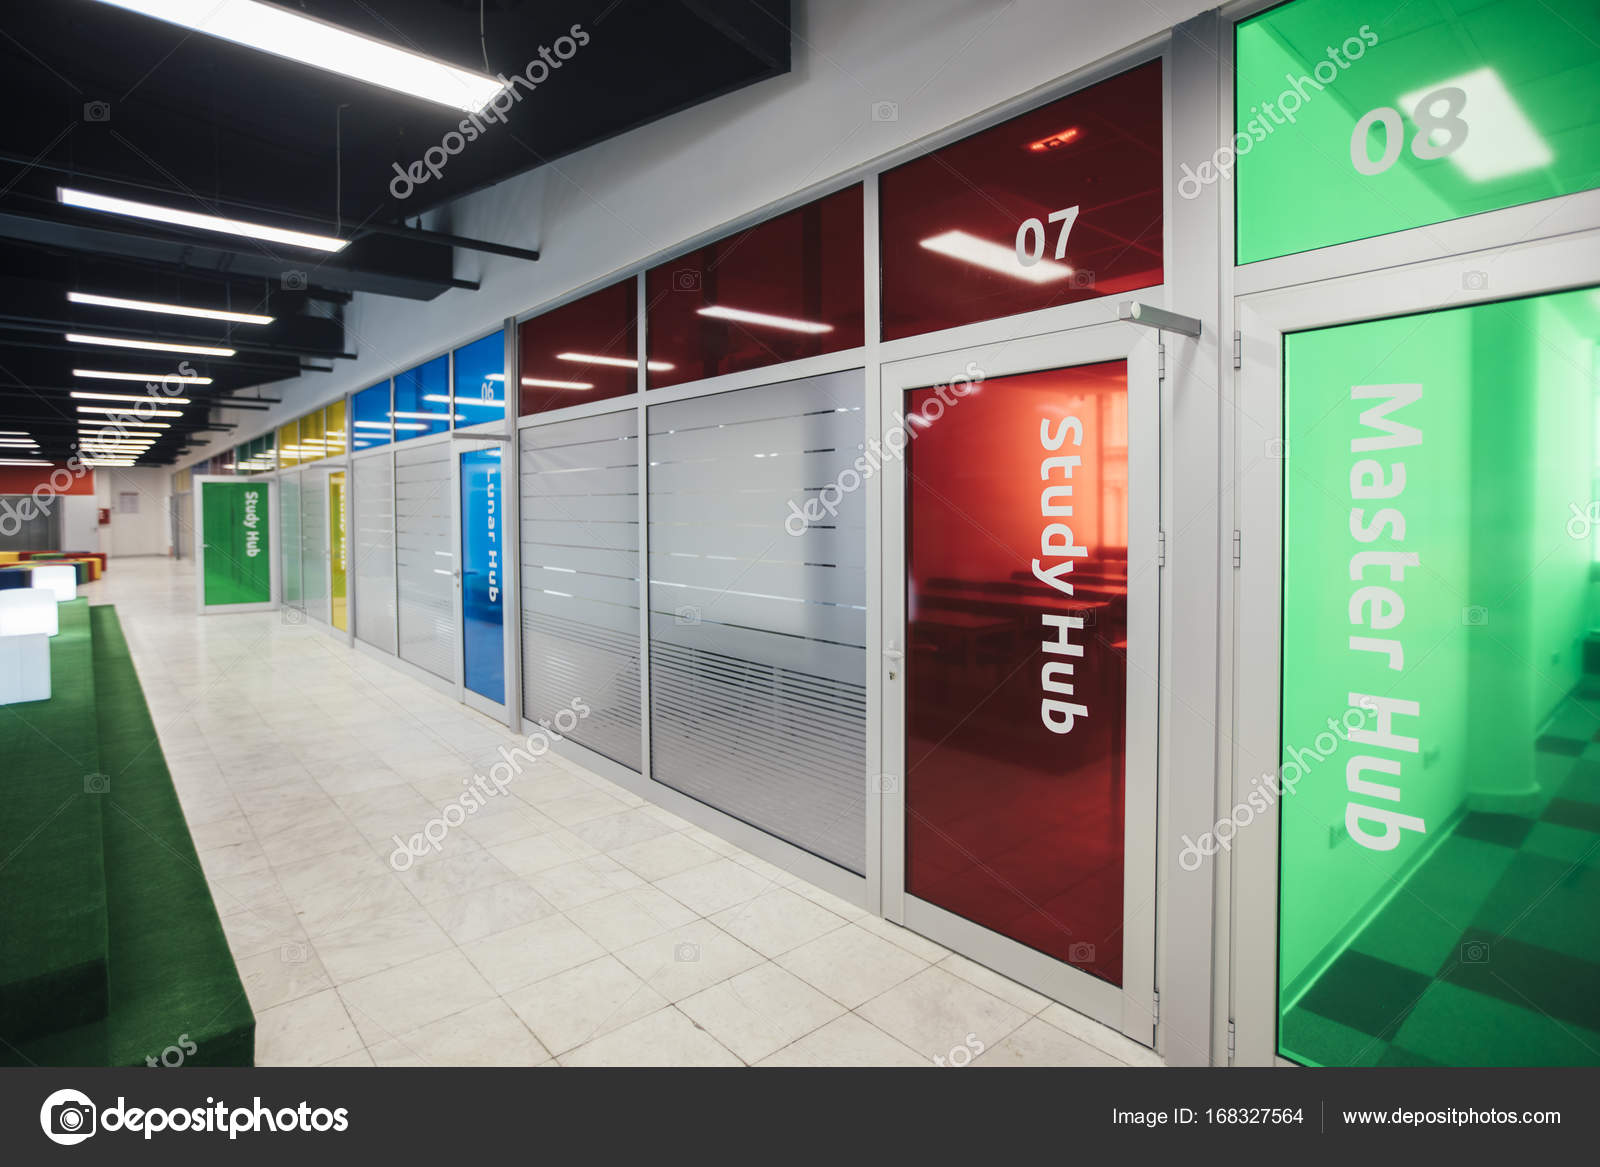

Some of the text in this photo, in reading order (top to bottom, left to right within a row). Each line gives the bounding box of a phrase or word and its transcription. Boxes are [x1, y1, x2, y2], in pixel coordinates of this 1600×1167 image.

[1350, 87, 1469, 176] 08
[1015, 205, 1080, 267] 07
[243, 491, 261, 557] Study Hub
[487, 467, 500, 603] Lunar Hub
[1031, 416, 1089, 735] Study Hub
[1345, 383, 1426, 851] Master Hub
